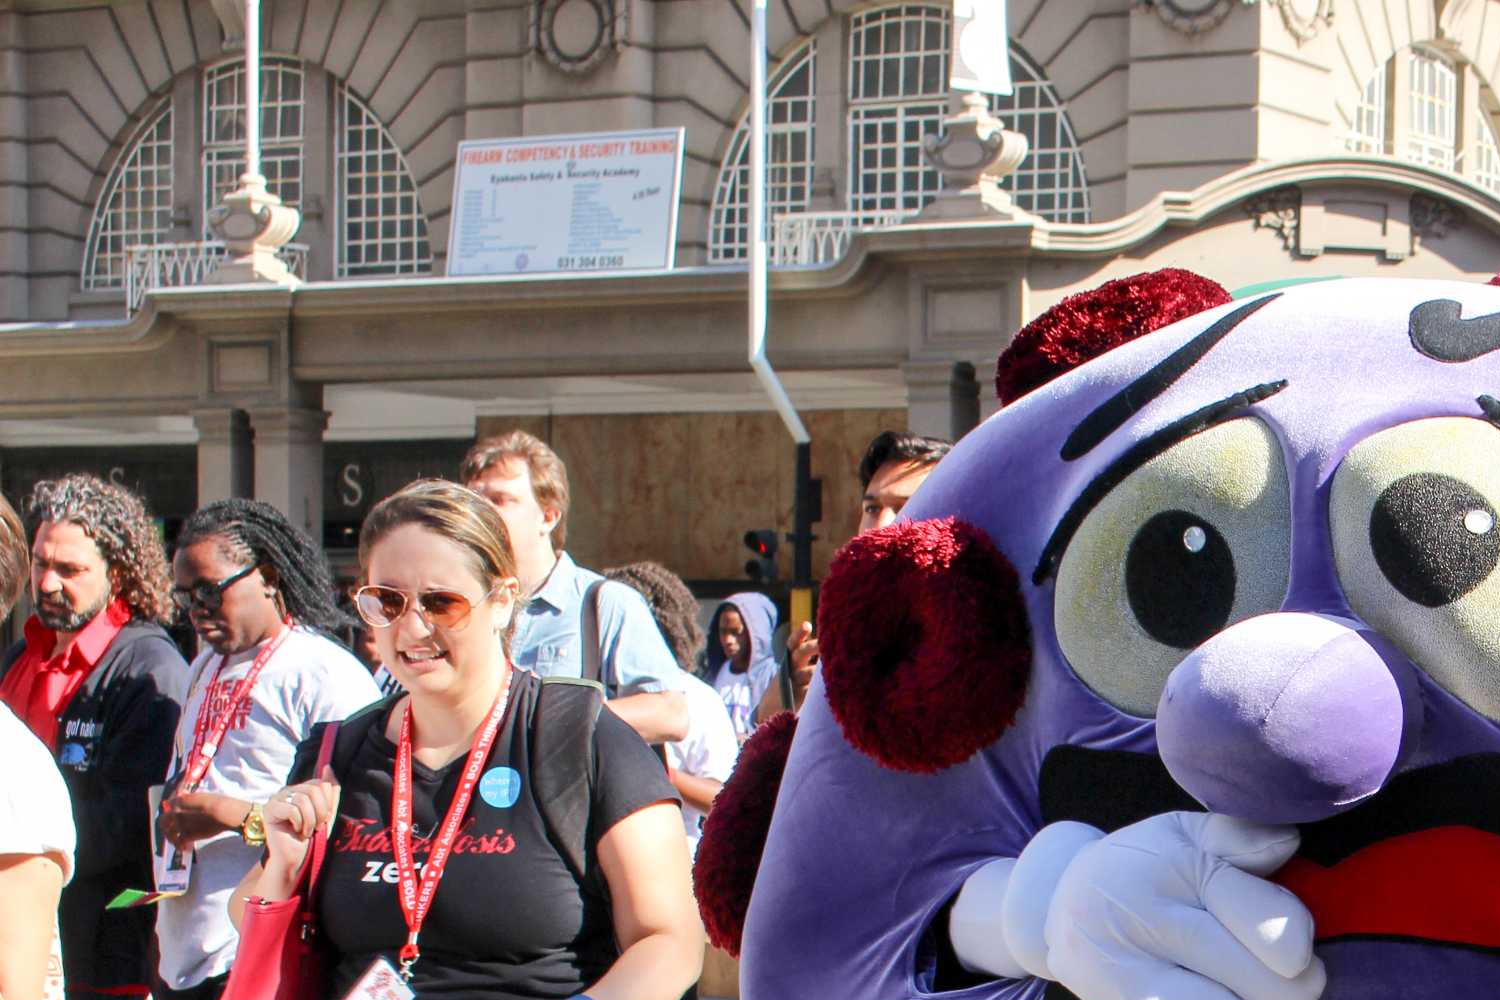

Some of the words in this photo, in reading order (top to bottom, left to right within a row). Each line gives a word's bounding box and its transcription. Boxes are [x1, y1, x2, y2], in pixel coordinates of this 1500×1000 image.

[463, 149, 503, 166] FIREARM
[506, 145, 567, 163] COMPETENCY
[578, 141, 625, 160] SECURITY
[628, 138, 675, 157] TRAINING
[567, 168, 600, 180] Security
[602, 166, 640, 179] Academy
[342, 463, 363, 507] S
[466, 750, 485, 782] BOLD
[432, 847, 447, 868] Abt
[443, 792, 469, 846] Associates
